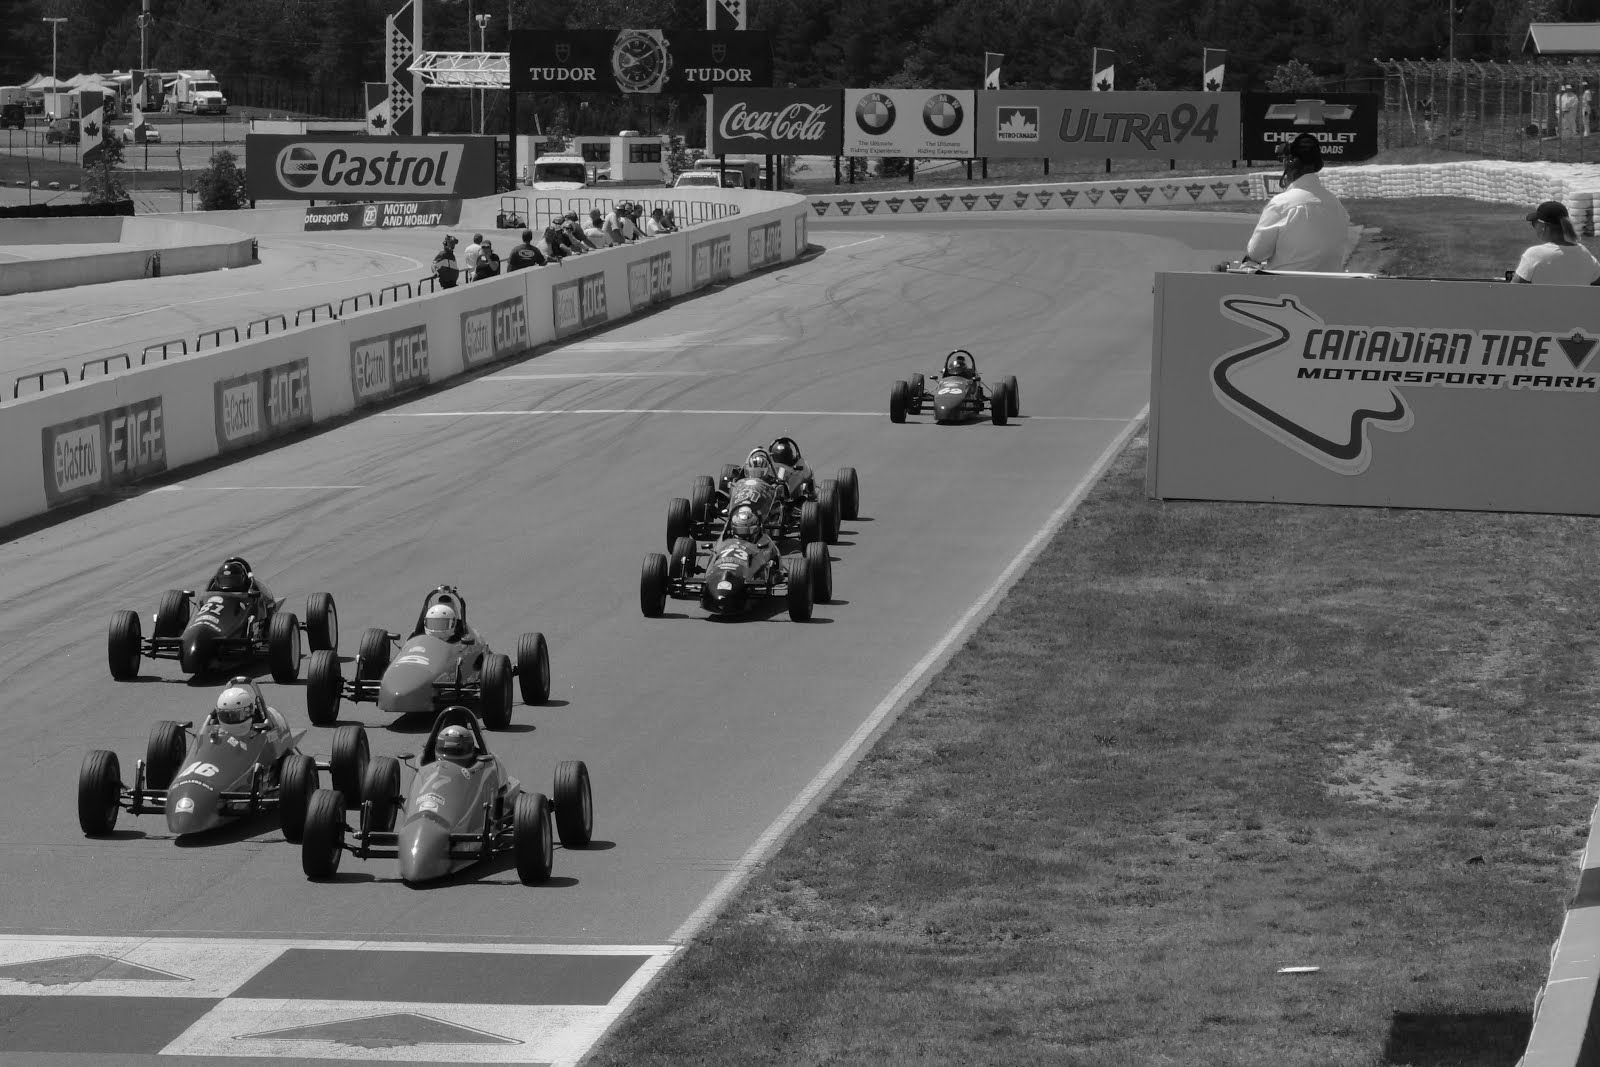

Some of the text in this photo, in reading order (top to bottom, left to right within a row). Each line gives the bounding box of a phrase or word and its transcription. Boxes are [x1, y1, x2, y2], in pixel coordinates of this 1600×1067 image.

[530, 67, 596, 81] TUDOR
[685, 68, 752, 82] TUDOR
[720, 102, 832, 141] Coca-Cola
[1263, 132, 1357, 143] CHEOLET
[1319, 145, 1344, 154] OADS
[321, 148, 449, 187] Castrol
[383, 203, 418, 215] MOTION
[382, 213, 442, 227] AND MOBILITY
[1480, 334, 1552, 368] TIRE
[1297, 367, 1596, 389] MOTORSPORT PARK
[63, 407, 163, 483] Castrol EDGE
